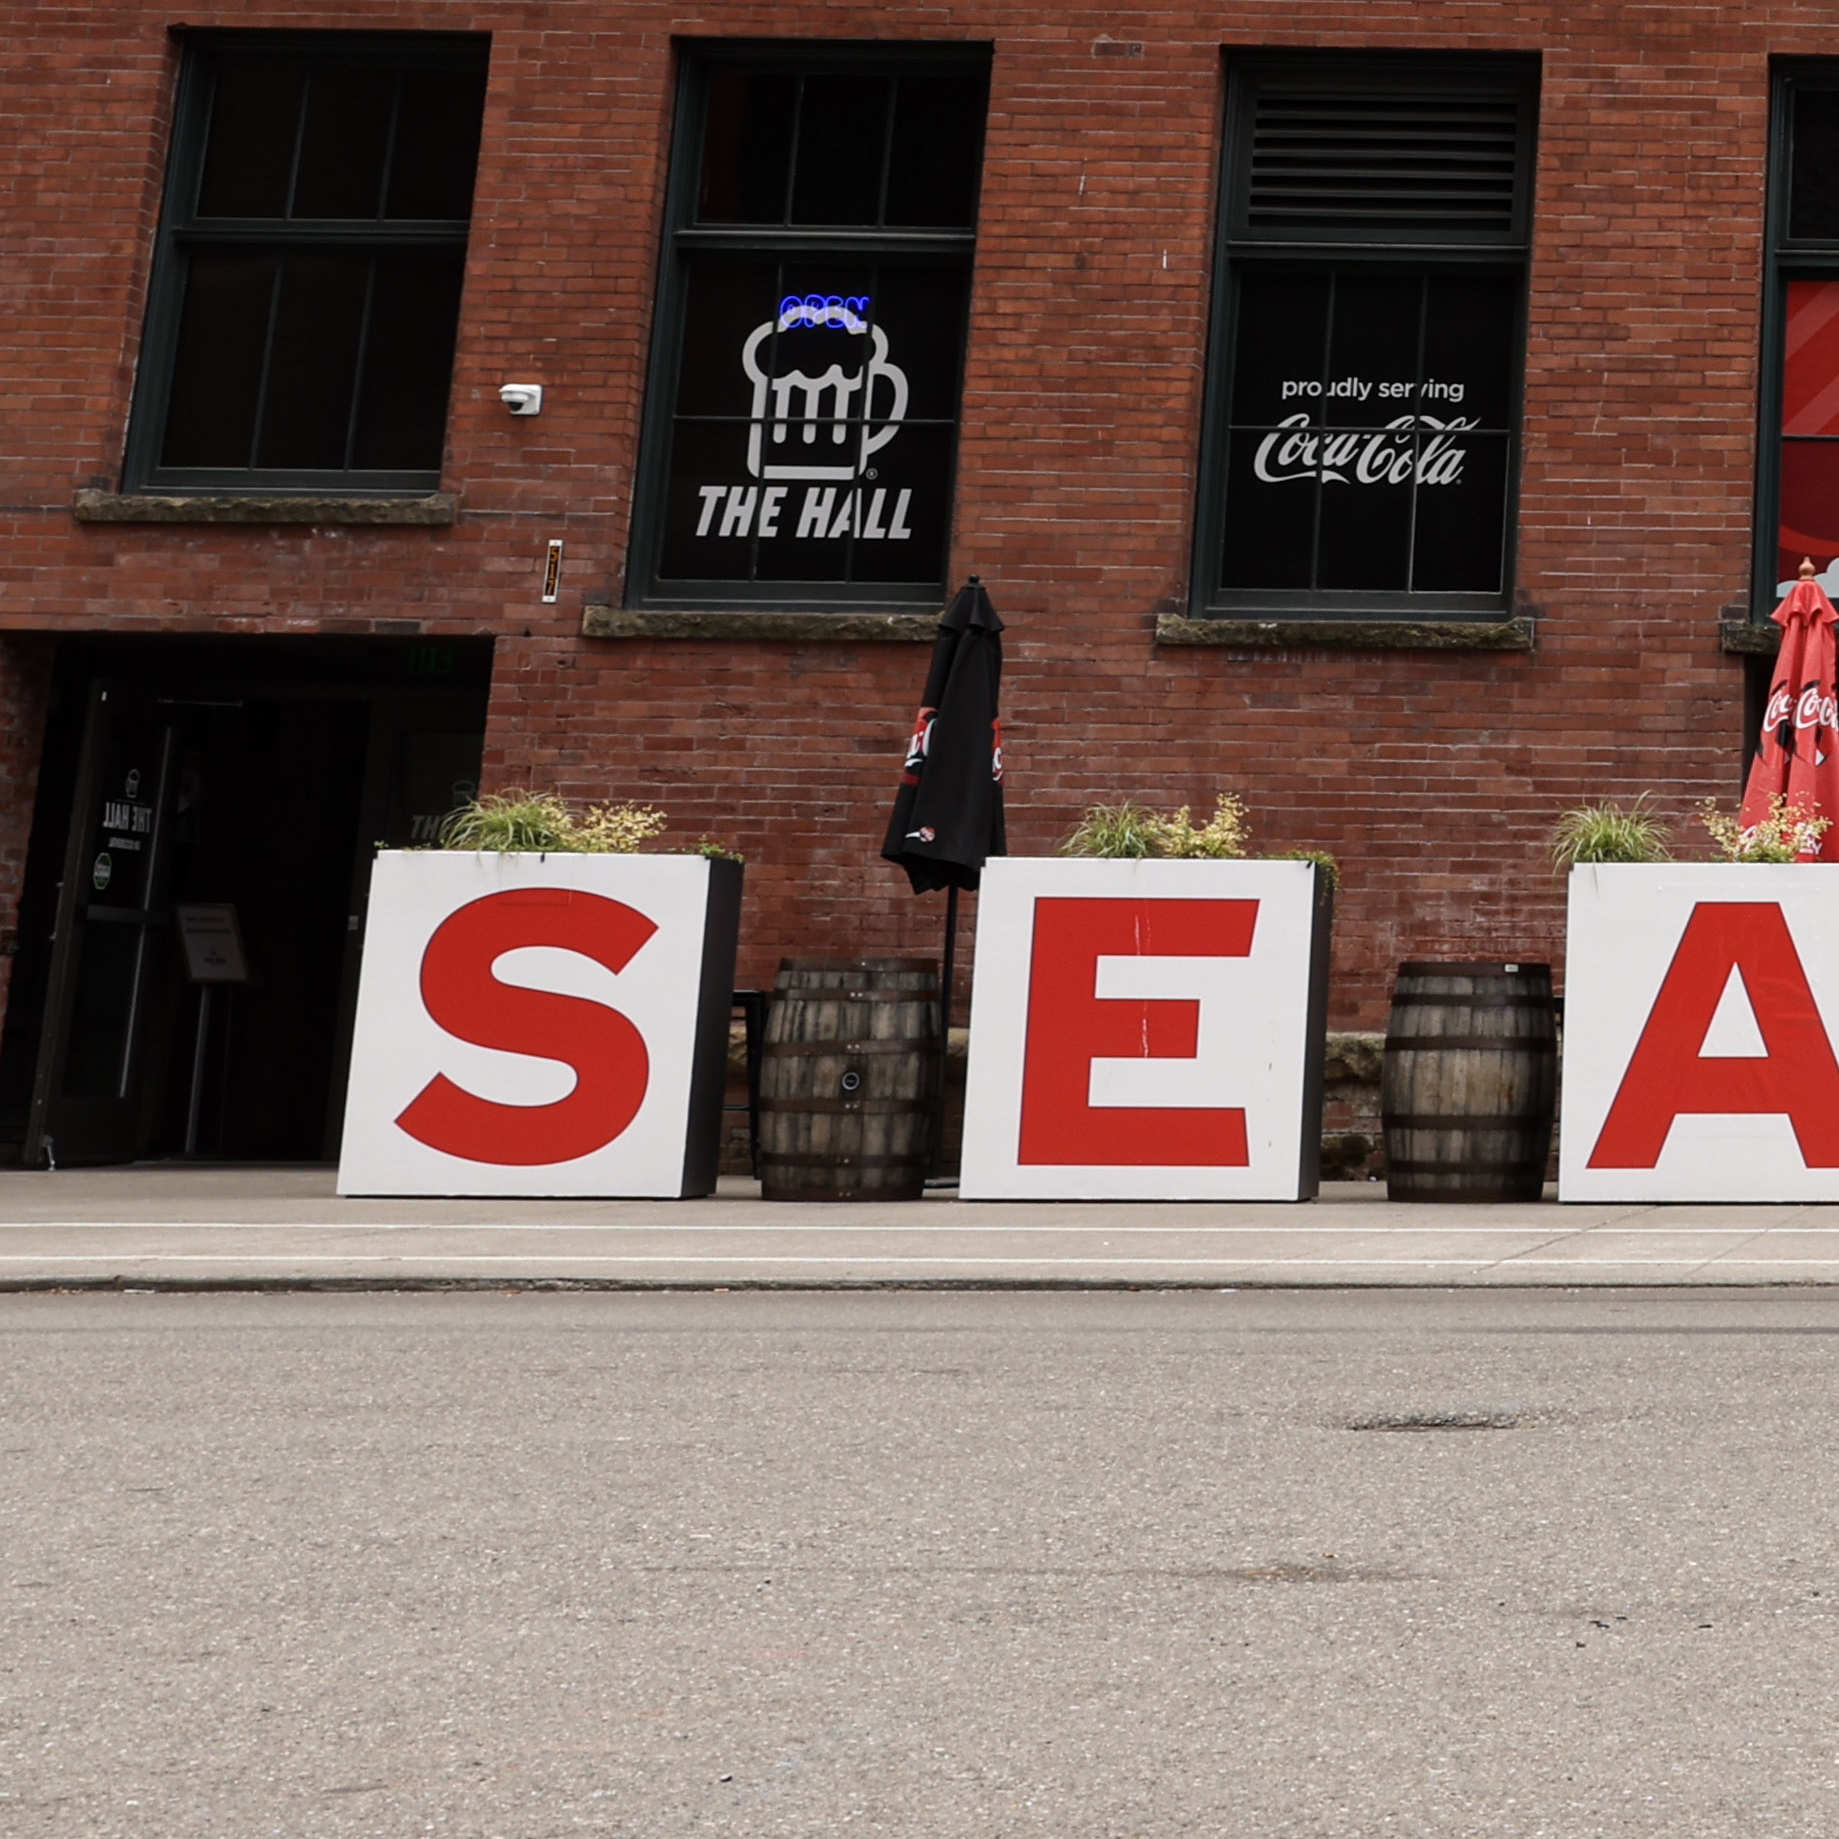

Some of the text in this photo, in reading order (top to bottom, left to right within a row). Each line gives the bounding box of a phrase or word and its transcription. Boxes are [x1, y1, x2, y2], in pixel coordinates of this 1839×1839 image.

[780, 294, 870, 329] OPEN
[1254, 413, 1481, 485] Coca-Cola
[696, 486, 912, 539] THE HALL
